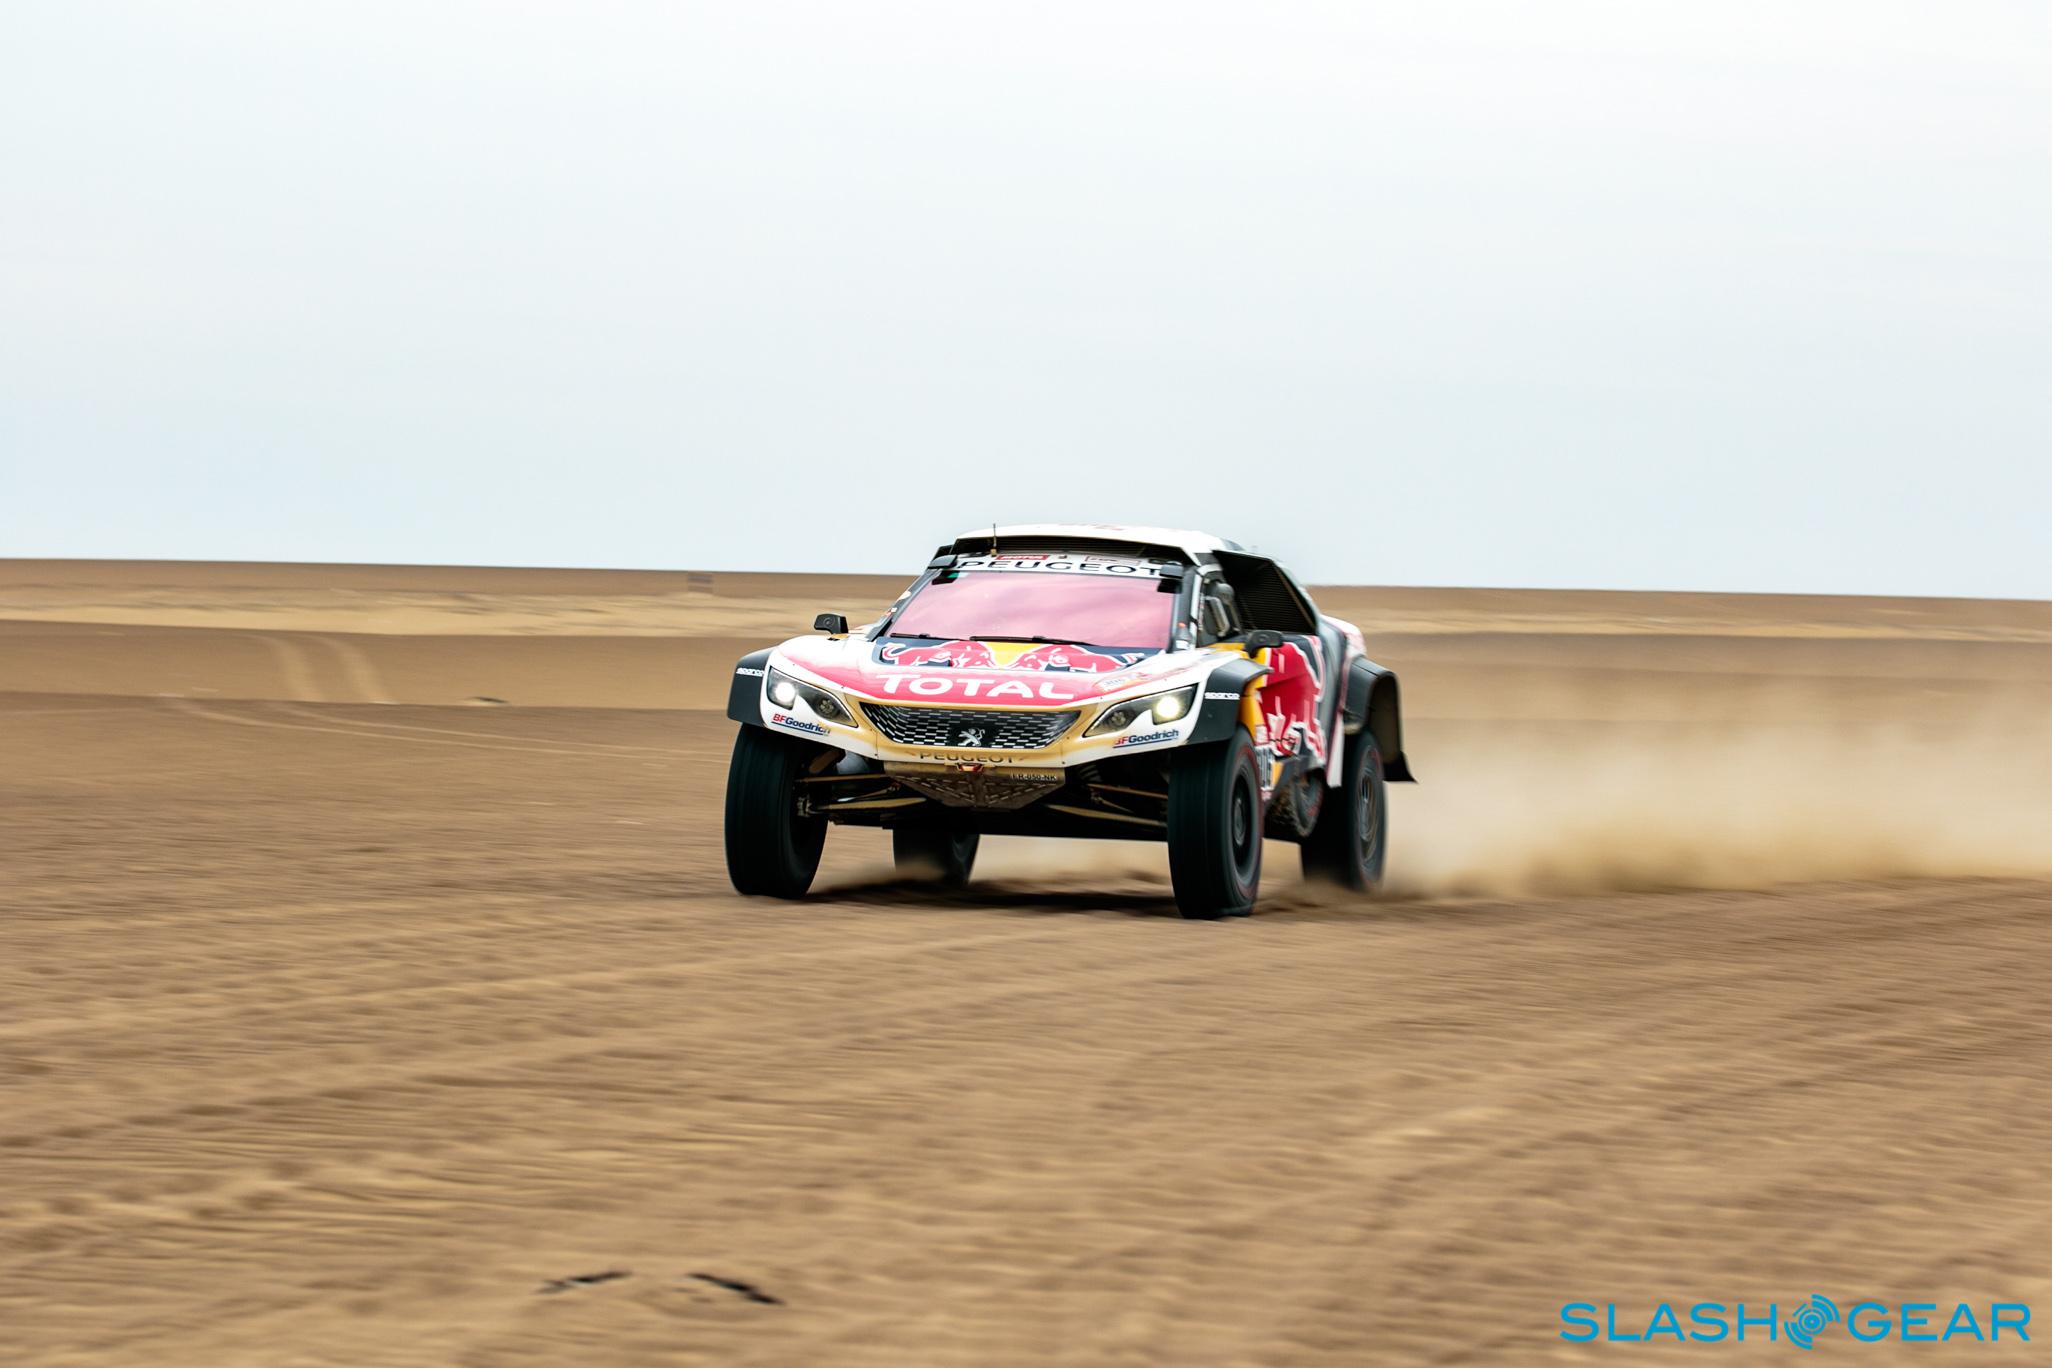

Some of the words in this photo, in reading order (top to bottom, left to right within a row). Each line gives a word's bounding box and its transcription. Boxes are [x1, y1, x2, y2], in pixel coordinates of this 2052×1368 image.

[957, 560, 1160, 576] PEUGEOT
[876, 673, 1075, 699] TOTAL
[772, 713, 831, 735] BFGoodrich
[1114, 729, 1179, 745] BFGoodrich
[919, 751, 1014, 764] PEUGEOT
